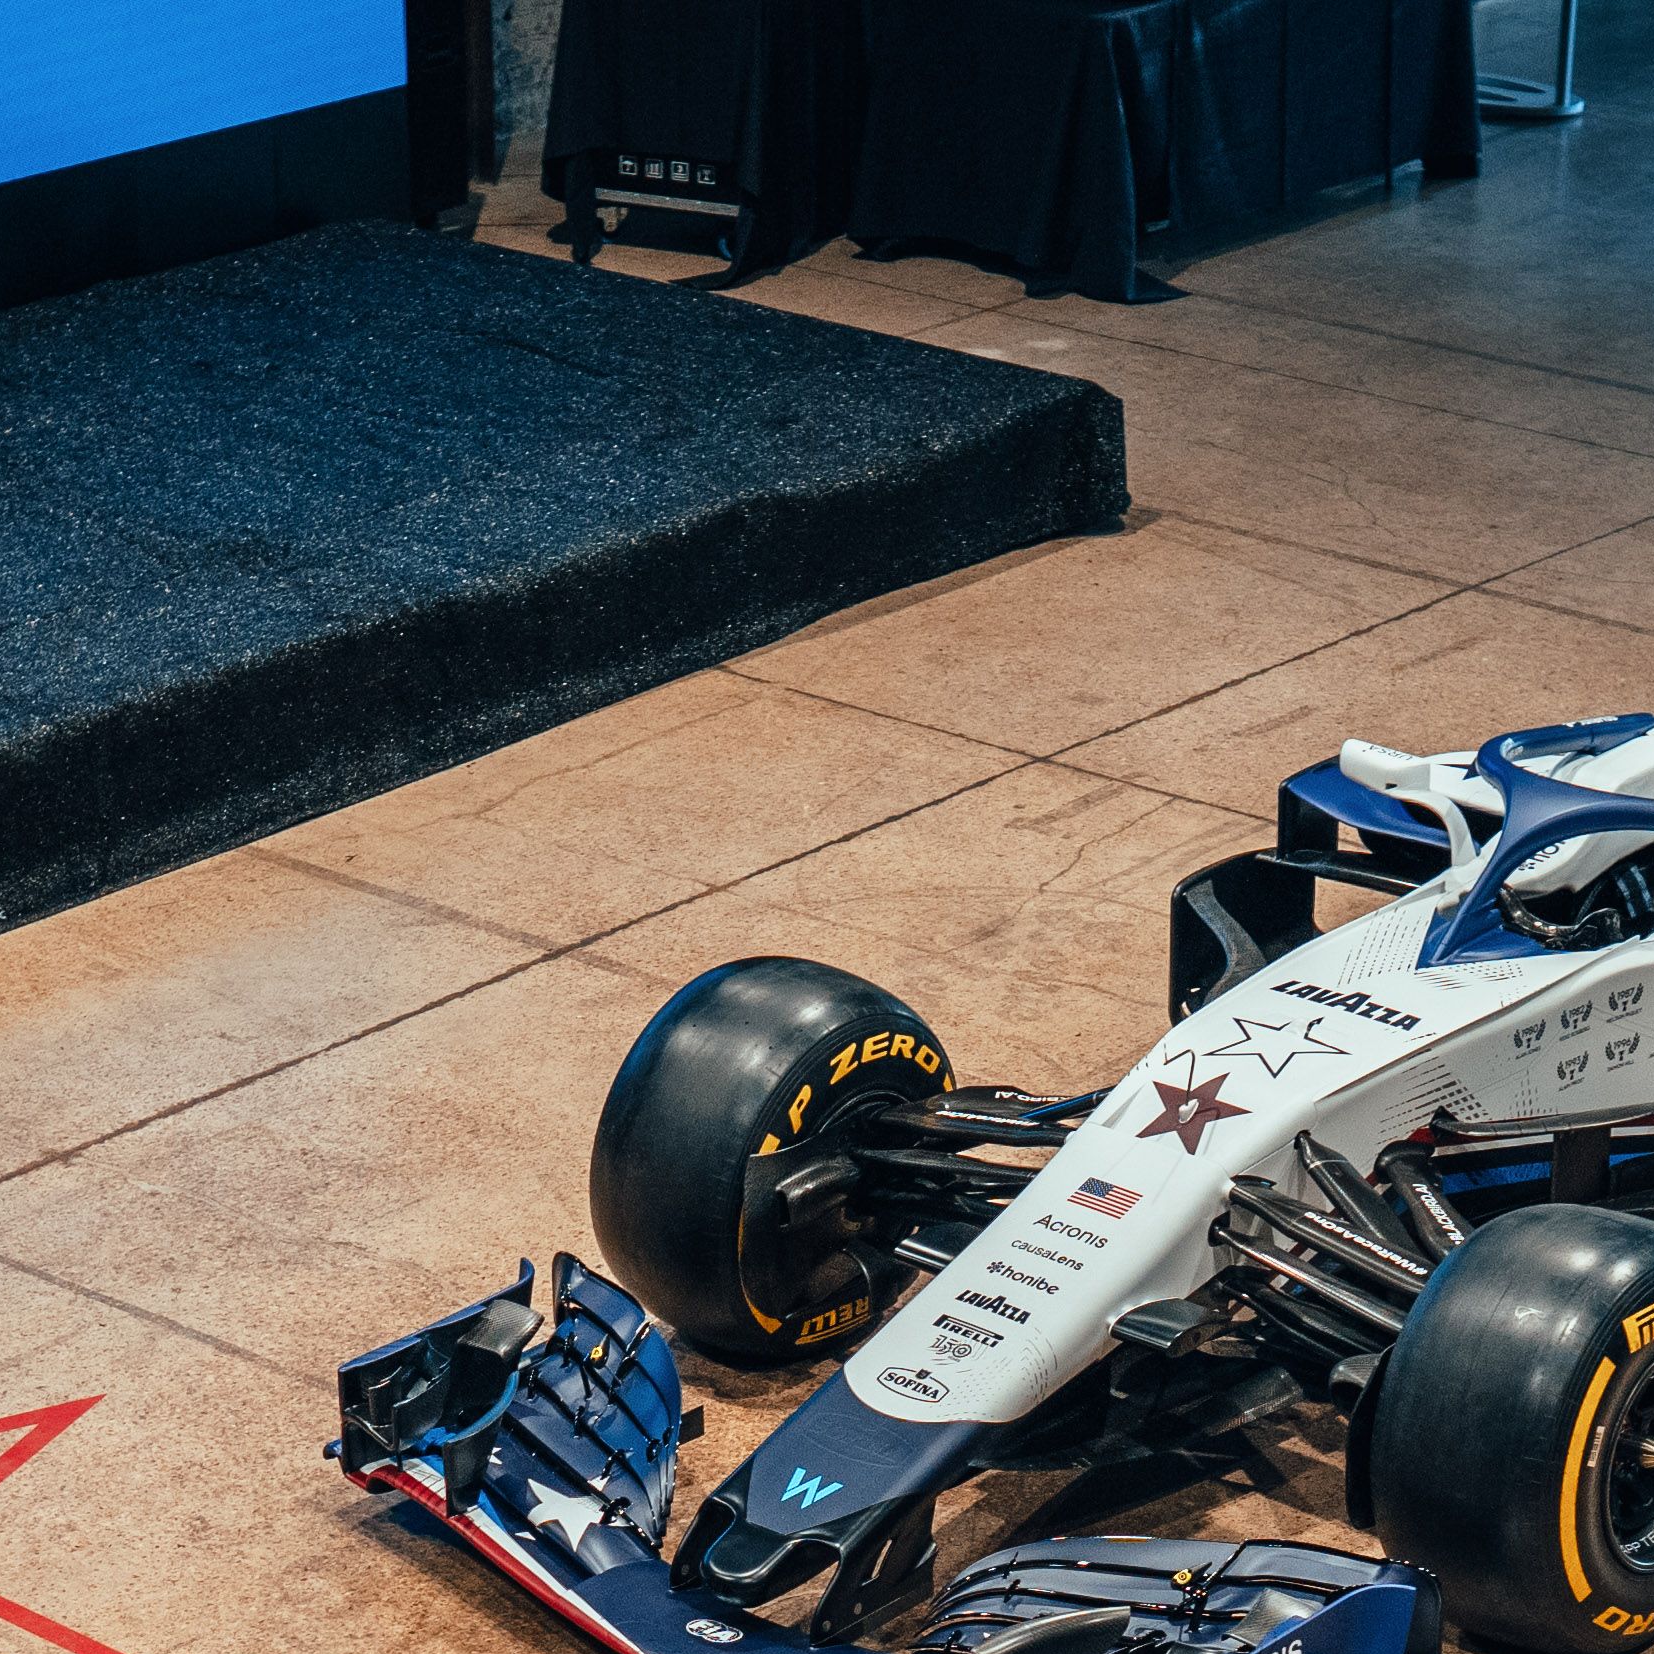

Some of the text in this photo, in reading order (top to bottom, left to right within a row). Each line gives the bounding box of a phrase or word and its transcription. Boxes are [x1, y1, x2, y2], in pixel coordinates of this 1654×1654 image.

[1269, 980, 1421, 1031] LAVAZZA
[788, 1031, 941, 1134] P ZERO
[1032, 1214, 1108, 1249] Acronis
[1011, 1239, 1084, 1271] causaLens
[1000, 1265, 1059, 1295] honibe
[955, 1289, 1031, 1325] LAVAZZA
[932, 1313, 1004, 1348] PIRELLI
[883, 1372, 940, 1400] SOFINA
[688, 1619, 739, 1641] FIA
